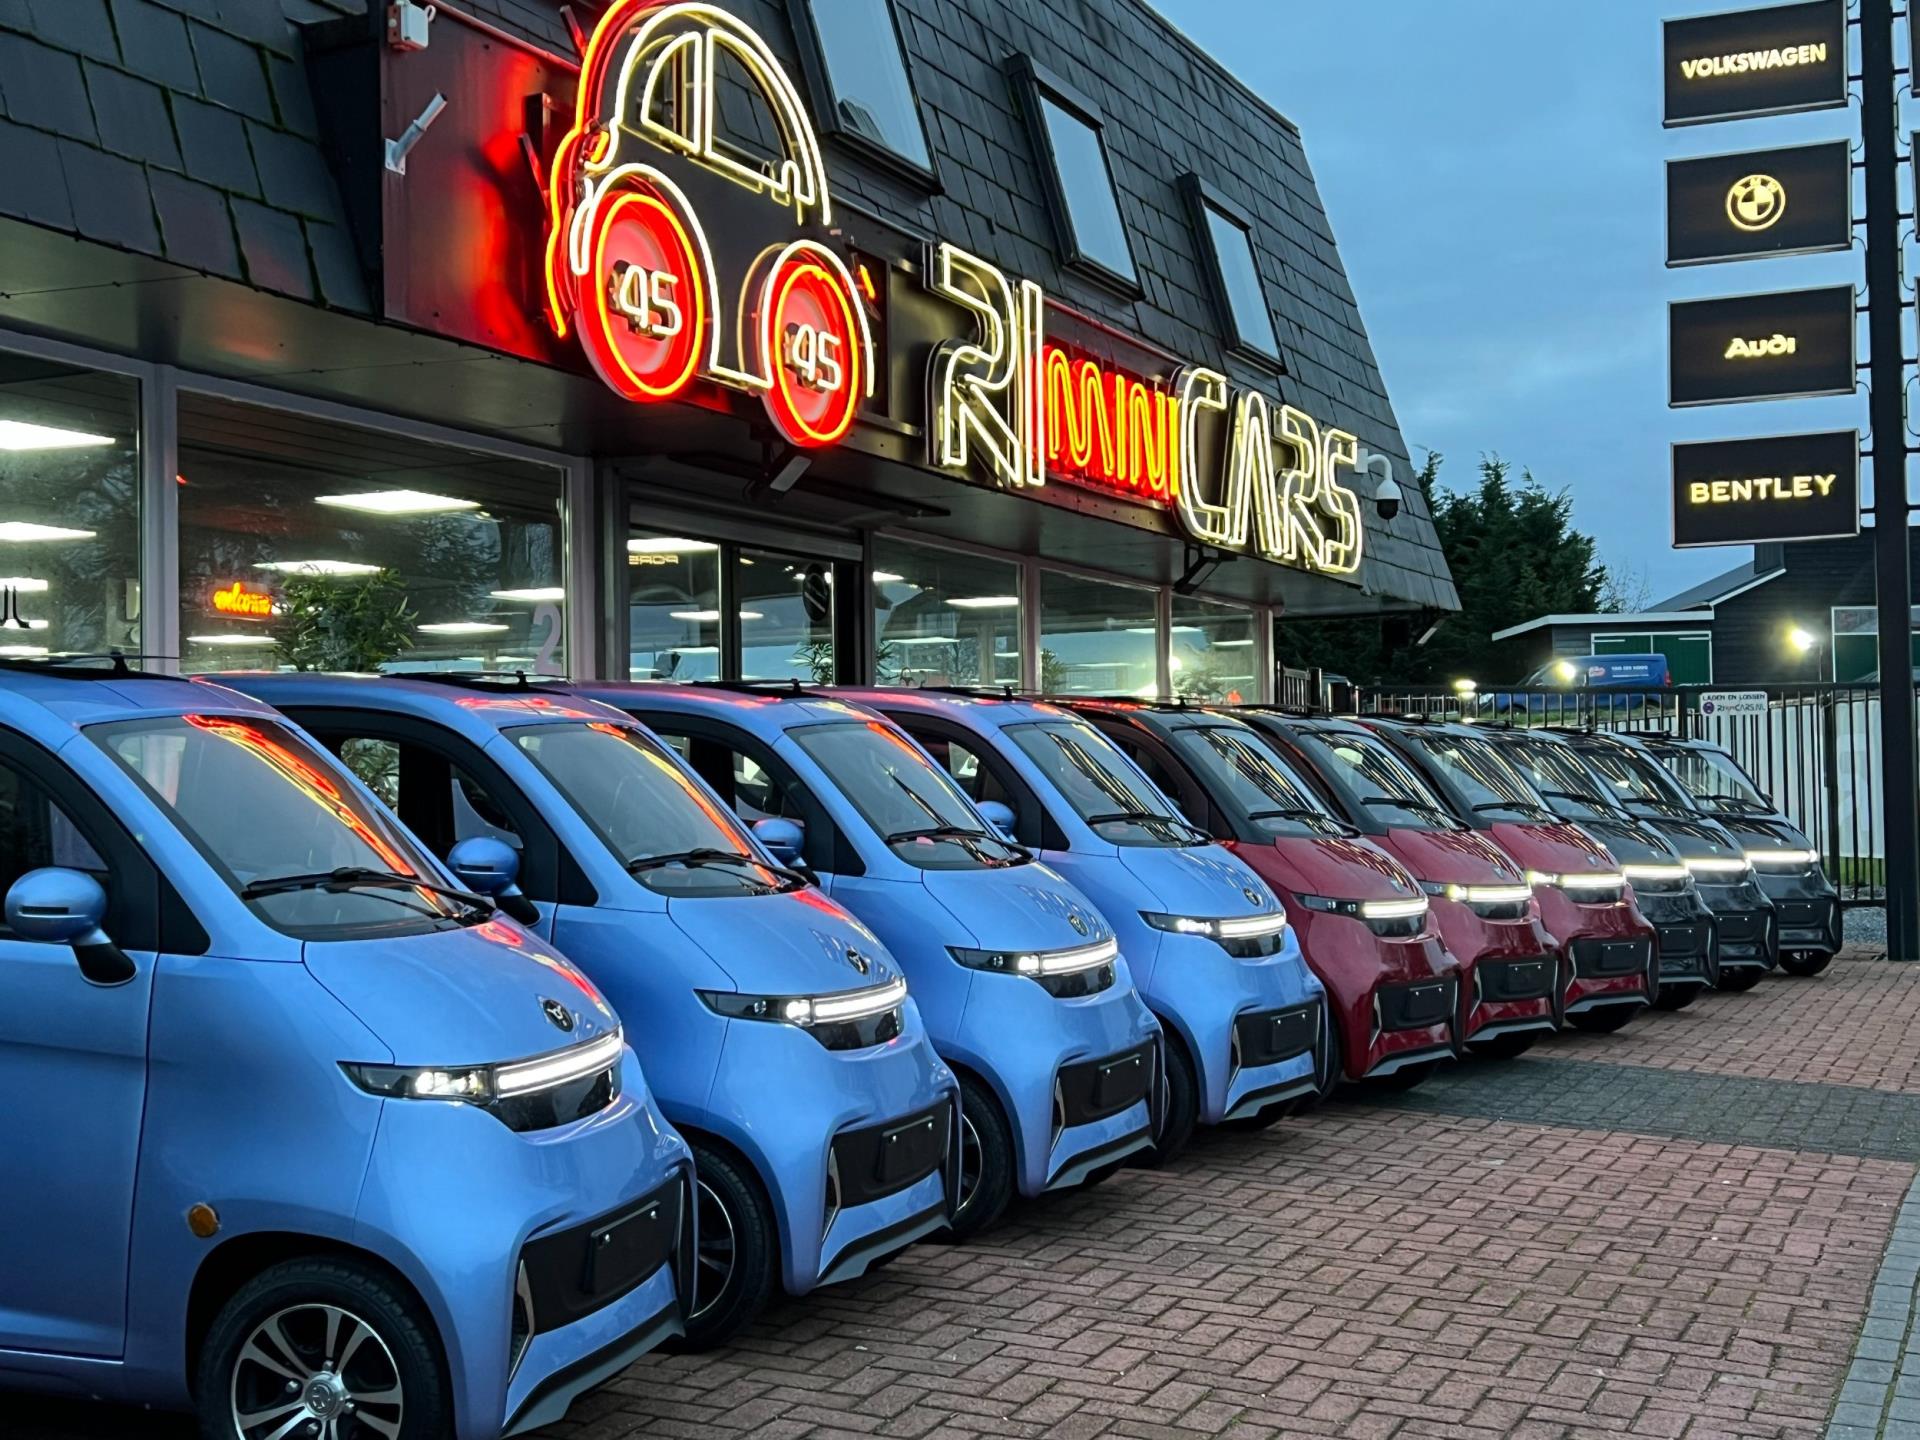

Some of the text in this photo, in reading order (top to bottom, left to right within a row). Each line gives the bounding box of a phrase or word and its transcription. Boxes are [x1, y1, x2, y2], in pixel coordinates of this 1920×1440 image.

[1681, 43, 1827, 79] VOLKSWAGEN
[620, 265, 682, 336] 45
[793, 323, 841, 390] 45
[1724, 334, 1796, 359] Audi
[1690, 474, 1836, 504] BENTLEY
